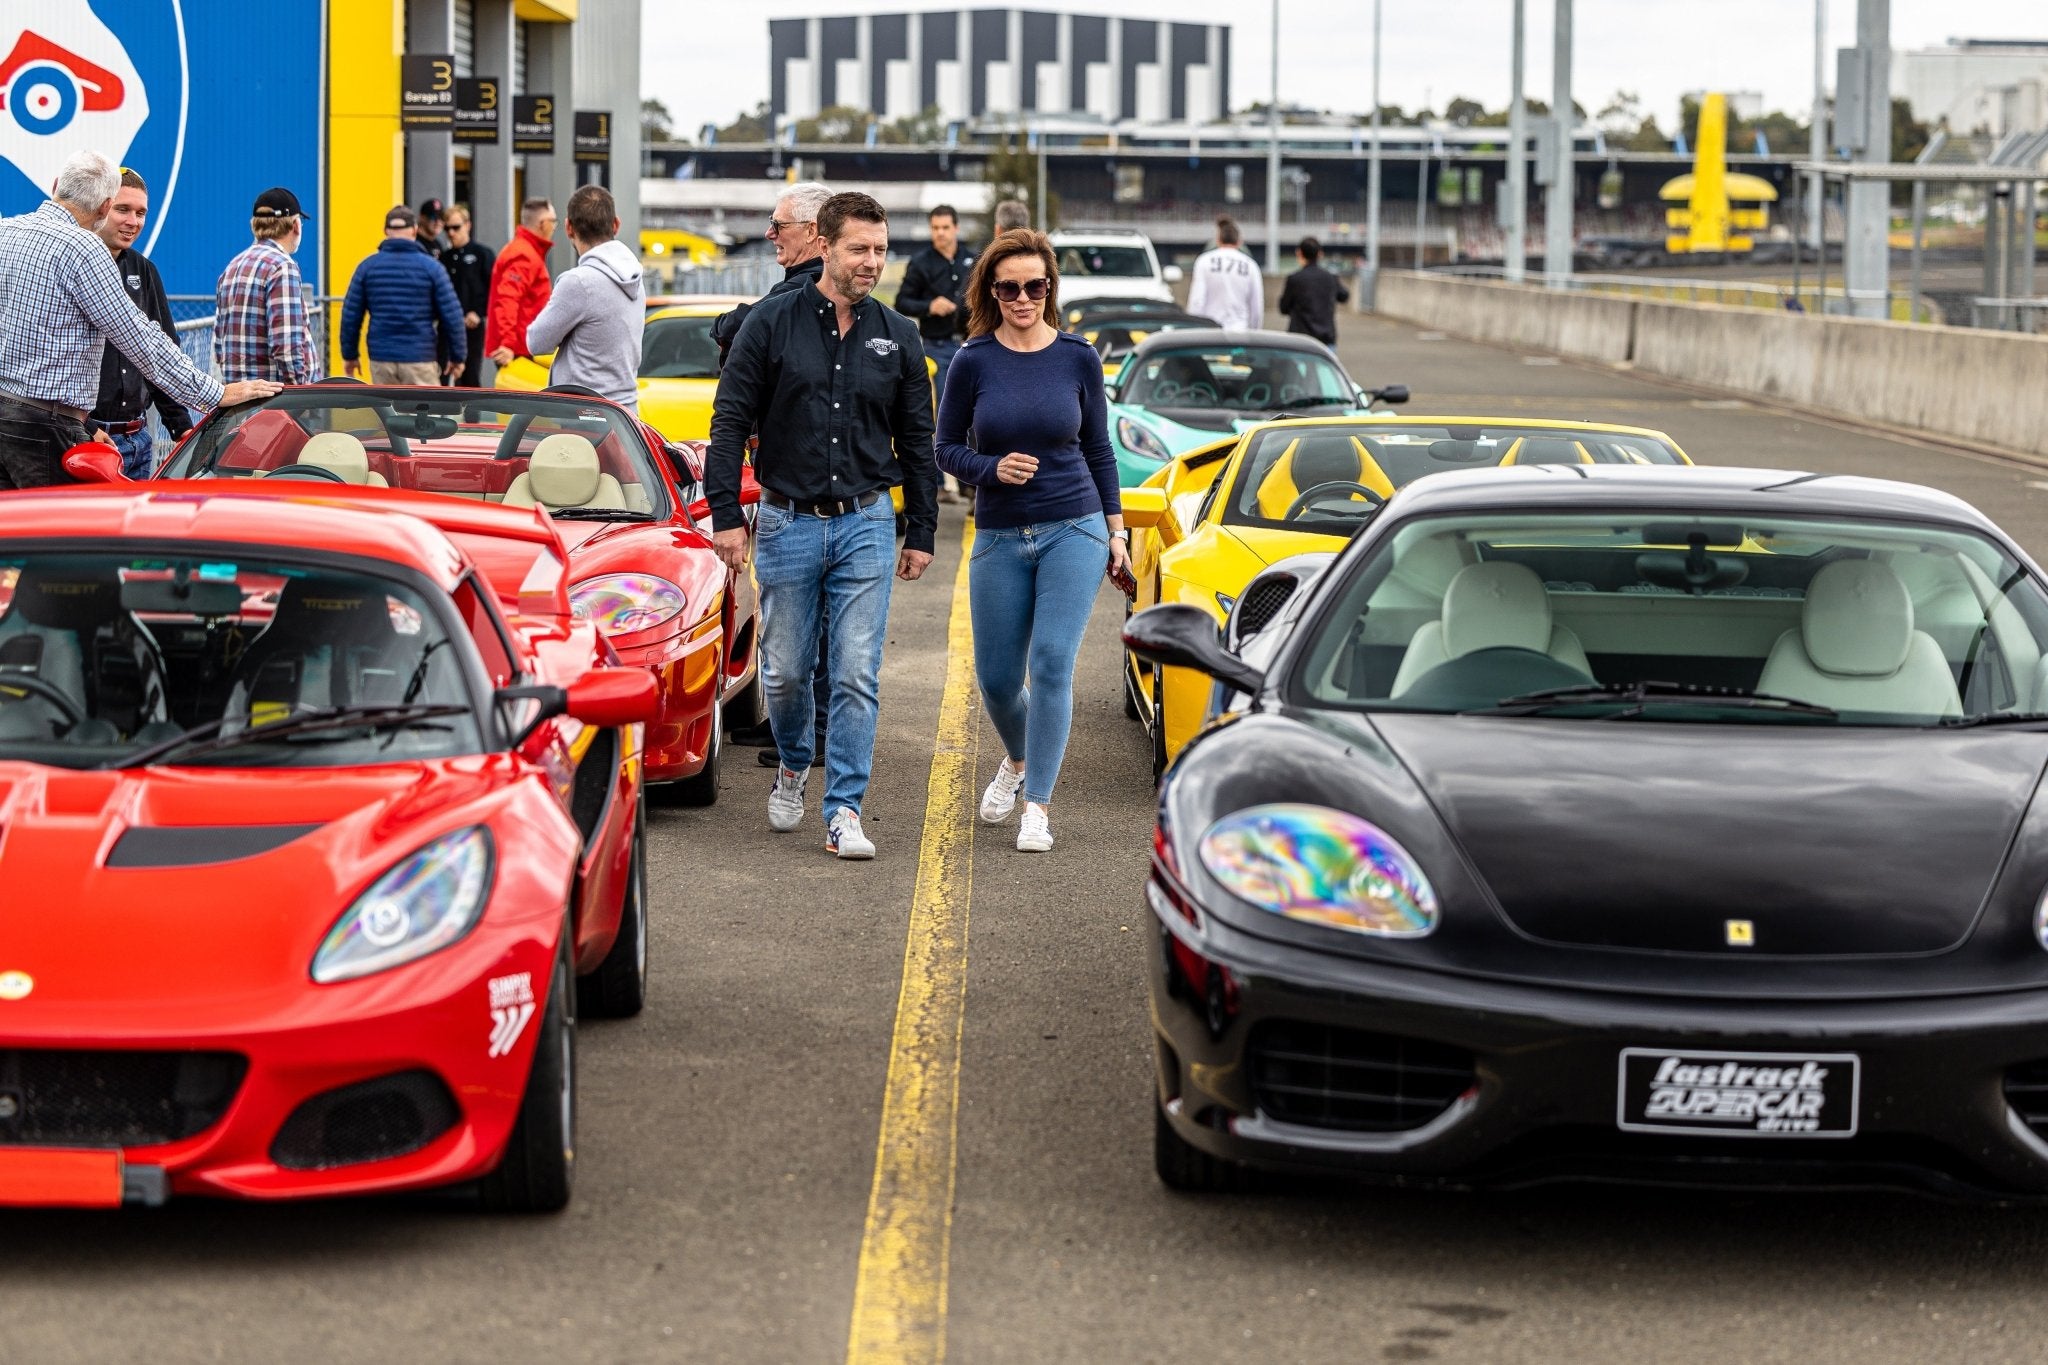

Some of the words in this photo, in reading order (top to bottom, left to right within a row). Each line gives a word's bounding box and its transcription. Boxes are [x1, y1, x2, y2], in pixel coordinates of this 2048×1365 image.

[432, 61, 452, 90] 3
[405, 91, 438, 105] Garage
[479, 82, 497, 109] 3
[455, 109, 484, 122] Garage
[534, 99, 552, 124] 2
[598, 114, 608, 138] 1
[1653, 1056, 1829, 1086] fastrack
[1647, 1087, 1825, 1117] SUPERCAR
[1757, 1117, 1820, 1132] drive
